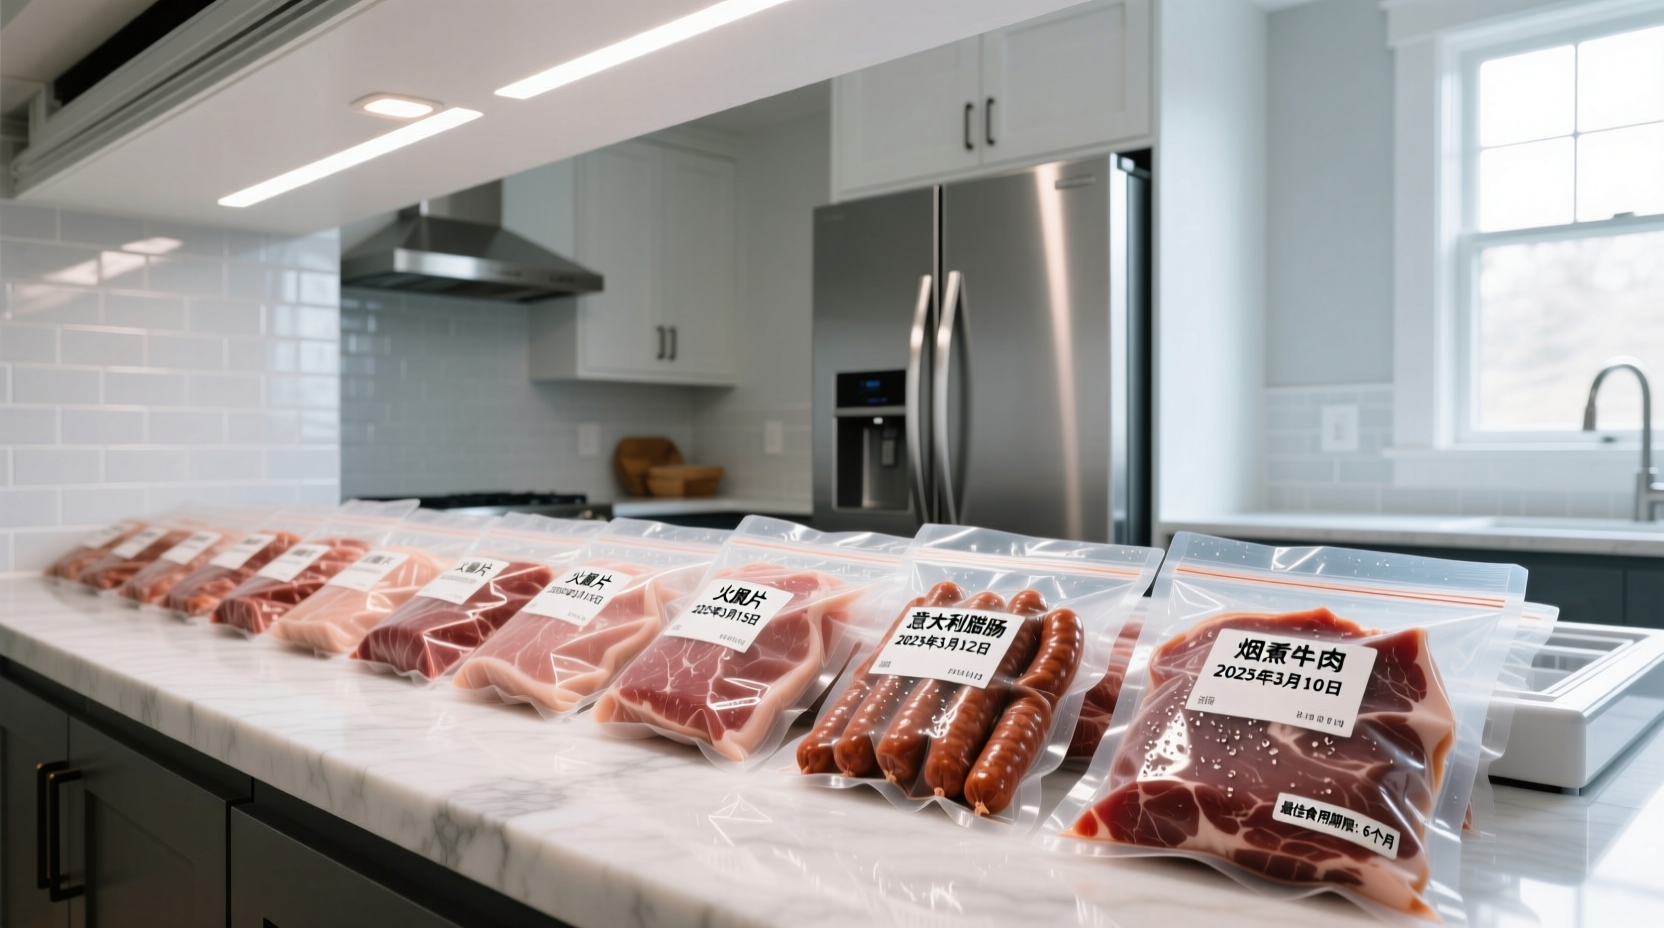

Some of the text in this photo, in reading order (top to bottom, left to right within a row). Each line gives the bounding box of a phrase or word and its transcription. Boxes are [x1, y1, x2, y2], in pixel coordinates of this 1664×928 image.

[906, 611, 1008, 639] 意大利腊肠
[1234, 637, 1347, 673] 烟煮牛肉
[1213, 664, 1343, 696] 2025年3月10日
